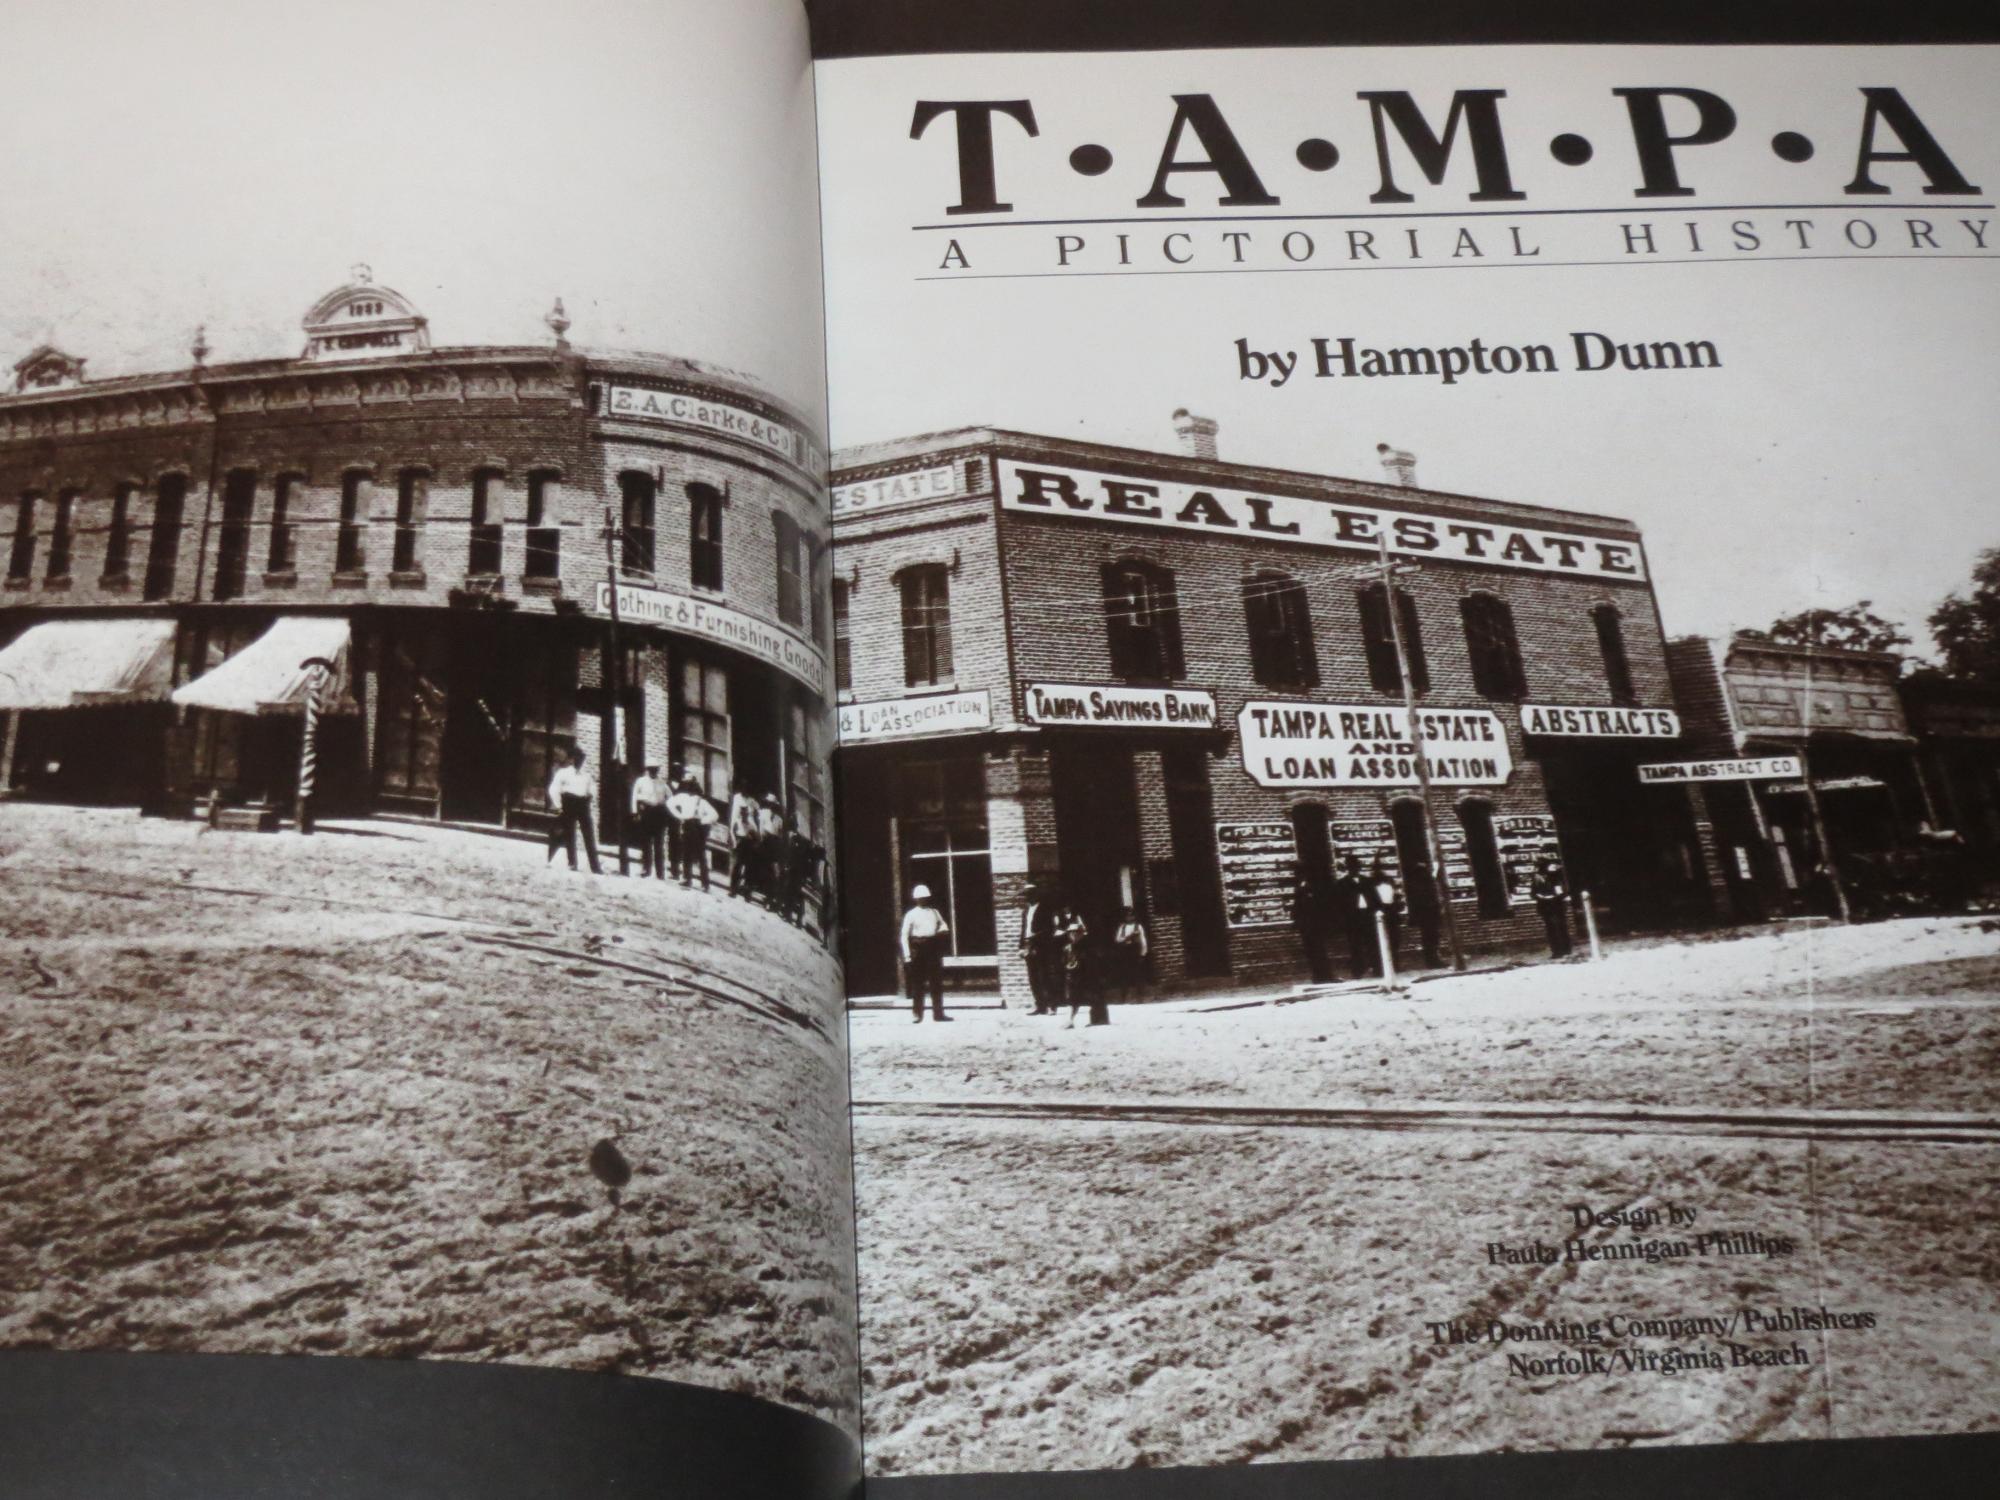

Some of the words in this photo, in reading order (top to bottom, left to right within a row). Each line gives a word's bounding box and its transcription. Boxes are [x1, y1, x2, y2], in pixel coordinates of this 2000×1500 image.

[938, 238, 972, 269] A
[1055, 226, 1541, 266] PICTORIAL
[1619, 219, 1990, 255] HISTORY
[1233, 337, 1298, 387] by
[1309, 335, 1558, 385] Hampton
[1569, 332, 1723, 372] Dunn
[832, 468, 949, 511] ESTATE
[1014, 468, 1300, 536] REAL
[1330, 508, 1638, 575] ESTATE
[601, 587, 673, 622] Cothing
[676, 601, 690, 625] &
[840, 711, 853, 733] &
[880, 700, 983, 732] ASSOCIATION
[1032, 688, 1089, 720] TAMPA
[1090, 691, 1163, 722] SAVINGS
[1164, 694, 1213, 723] BANK
[1531, 708, 1674, 736] ABSTRACTS
[1251, 708, 1335, 740] TAMPA
[1339, 711, 1403, 741] REAL
[1347, 742, 1416, 756] AND
[1264, 756, 1337, 780] LOAN
[1643, 765, 1689, 780] TAMPA
[1691, 761, 1763, 778] ABSTRACT
[1574, 1202, 1662, 1232] Design
[1668, 1203, 1698, 1231] by
[1486, 1238, 1560, 1265] Paula
[1564, 1234, 1690, 1265] Hennigan
[1699, 1230, 1795, 1259] Phillips
[1425, 1317, 1479, 1346] The
[1487, 1315, 1602, 1344] Donning
[1731, 1340, 1810, 1368] Beach
